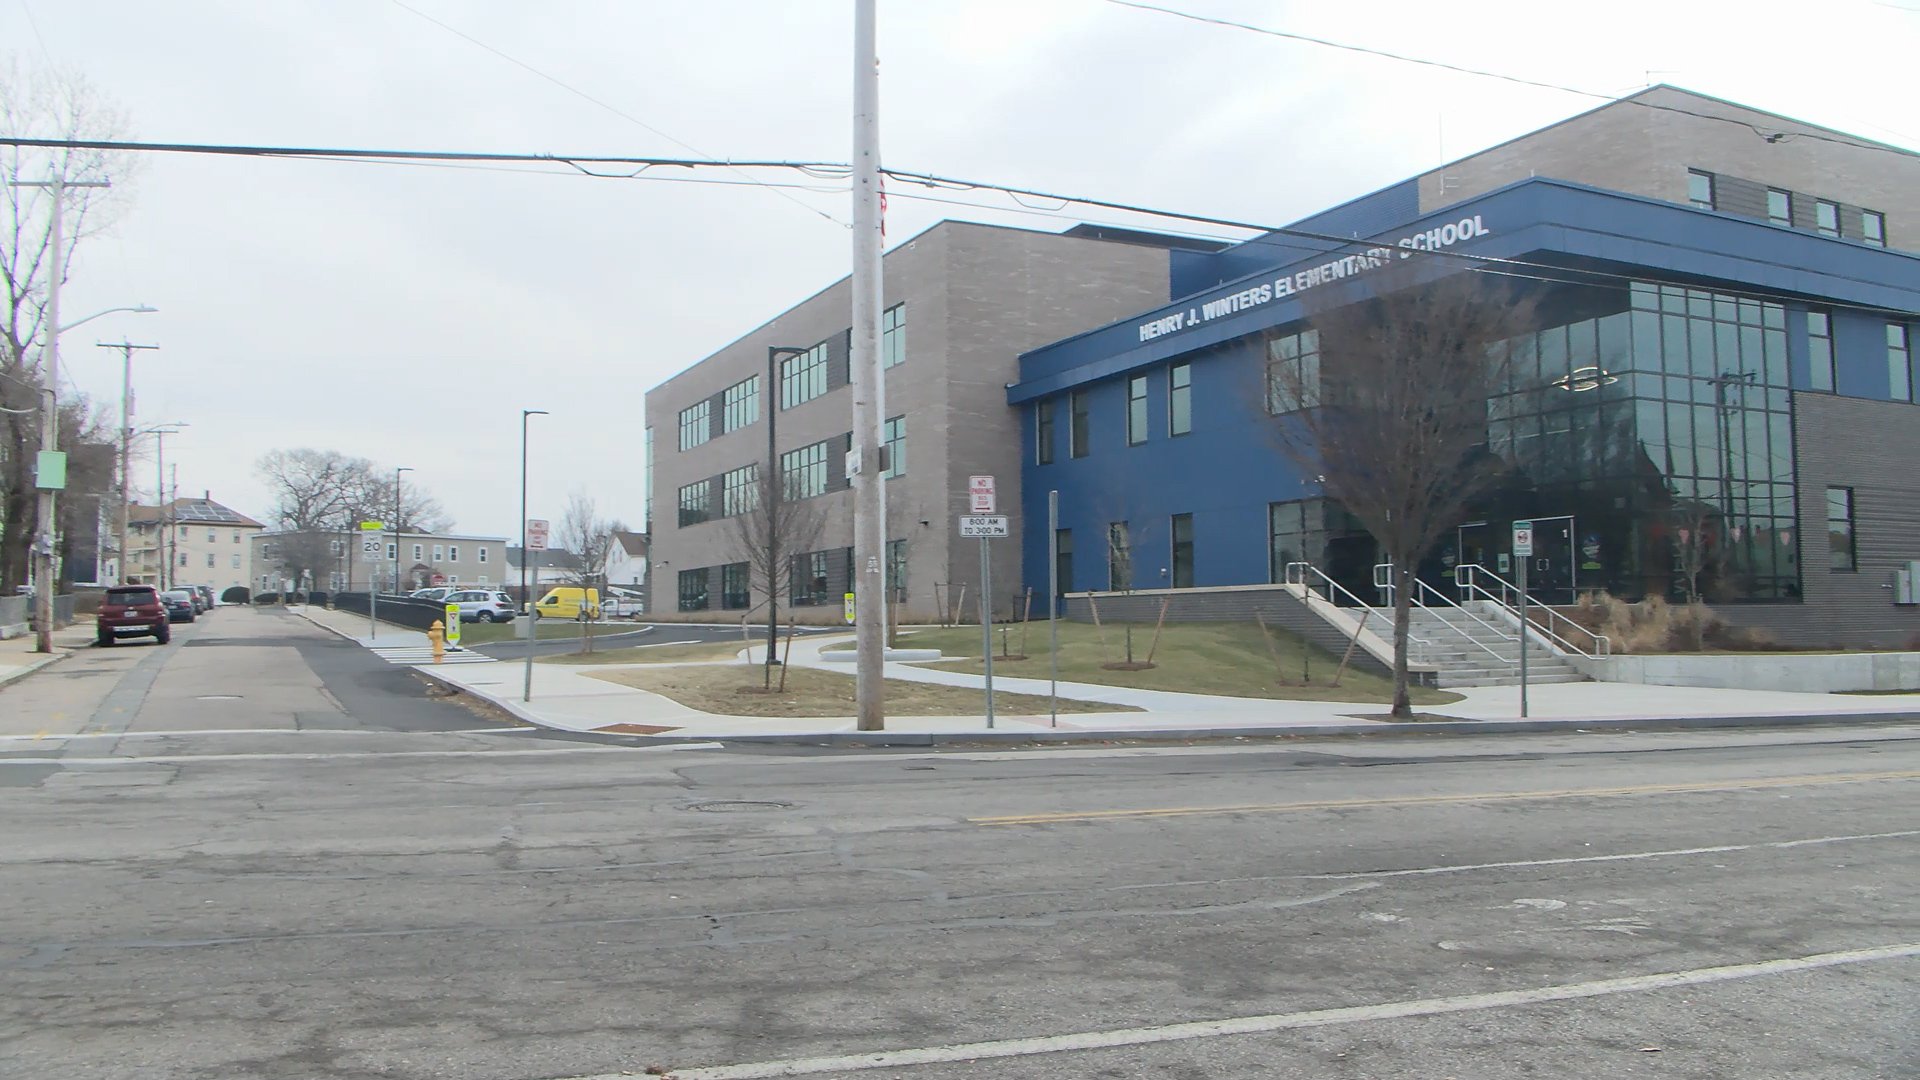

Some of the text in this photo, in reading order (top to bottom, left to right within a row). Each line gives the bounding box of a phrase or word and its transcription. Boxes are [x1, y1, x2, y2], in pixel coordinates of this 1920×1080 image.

[1139, 215, 1490, 342] HENRY J. WINTERS ELEMENTARY SCHOOL
[964, 527, 973, 535] TO
[1562, 529, 1568, 538] 1
[364, 542, 381, 552] 20
